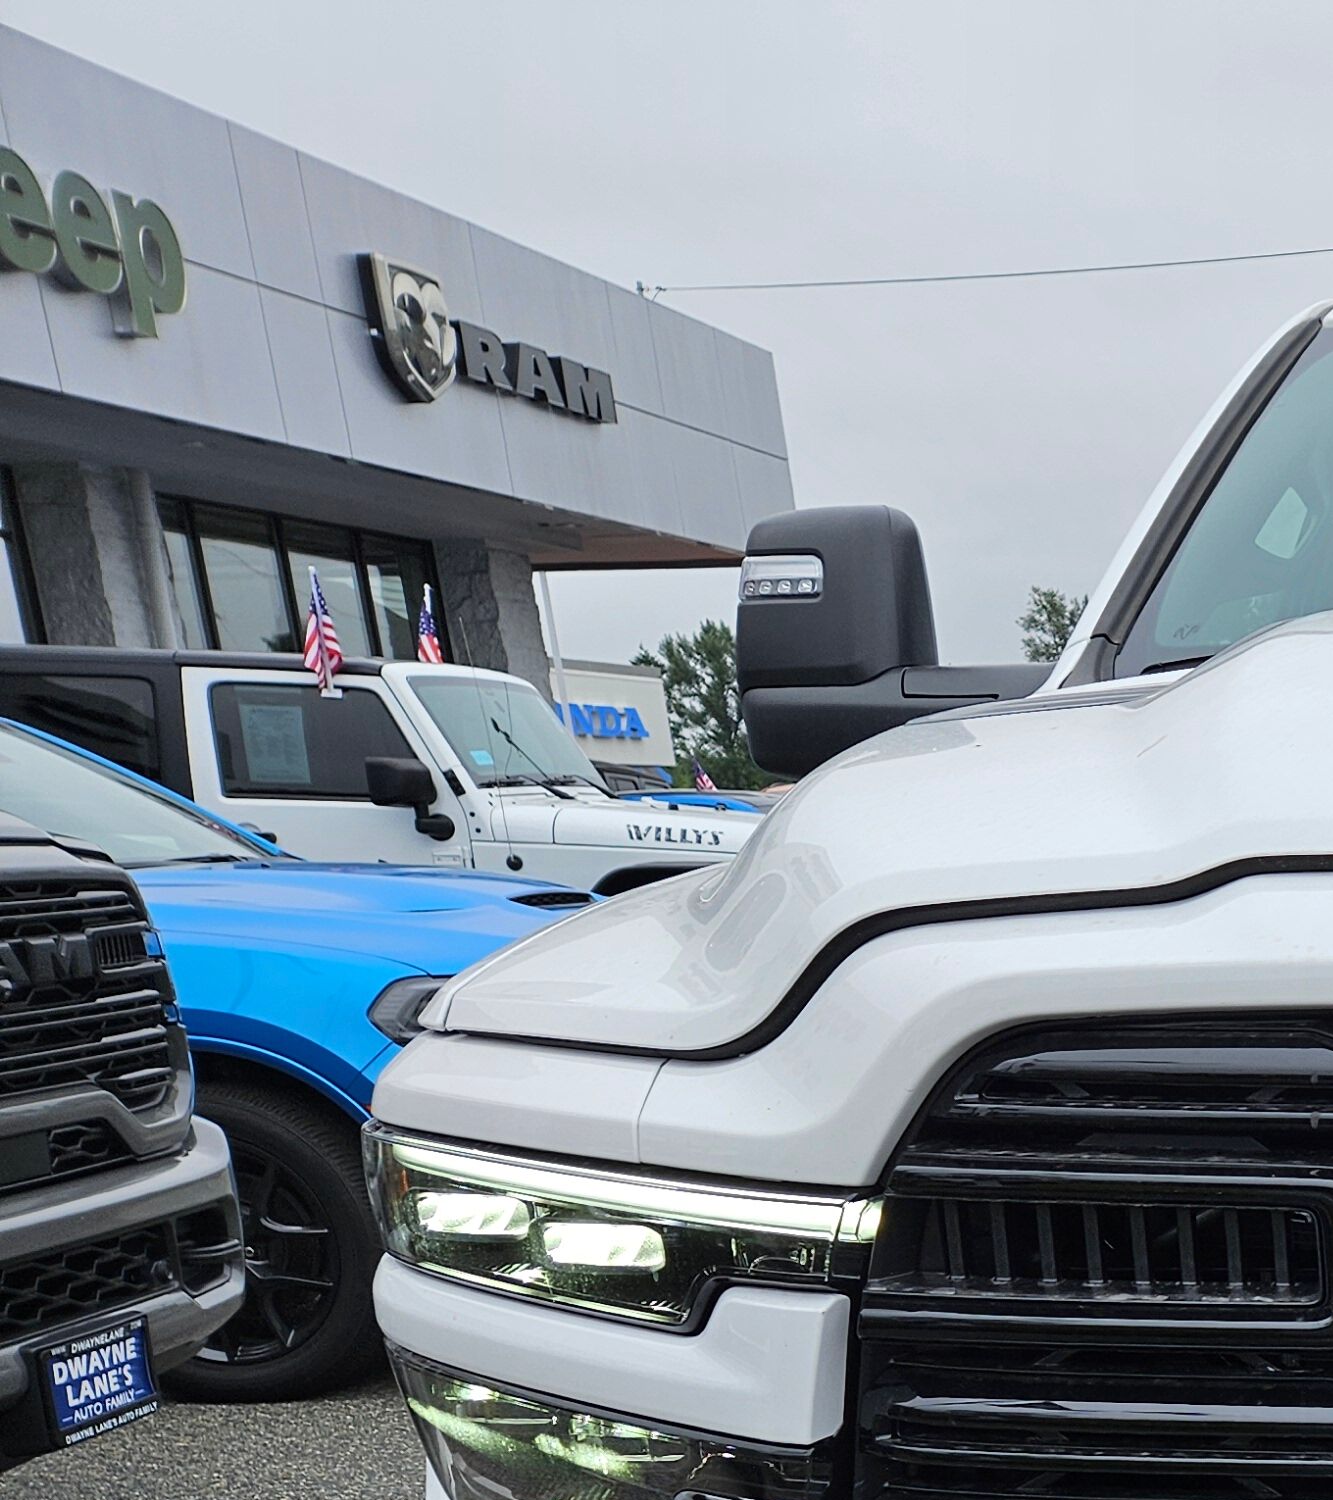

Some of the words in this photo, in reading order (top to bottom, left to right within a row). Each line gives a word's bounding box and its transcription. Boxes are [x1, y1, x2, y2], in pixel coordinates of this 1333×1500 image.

[0, 145, 187, 338] eep
[453, 320, 617, 424] RAM
[556, 702, 649, 738] NDA
[626, 824, 724, 846] WILLYS
[71, 1327, 124, 1353] DWAYNELANE
[52, 1337, 137, 1385] DWAYNE
[66, 1364, 133, 1407] LANE'S
[74, 1401, 103, 1423] AUTO
[105, 1388, 135, 1411] FAMILY
[65, 1426, 95, 1444] DWAYNE
